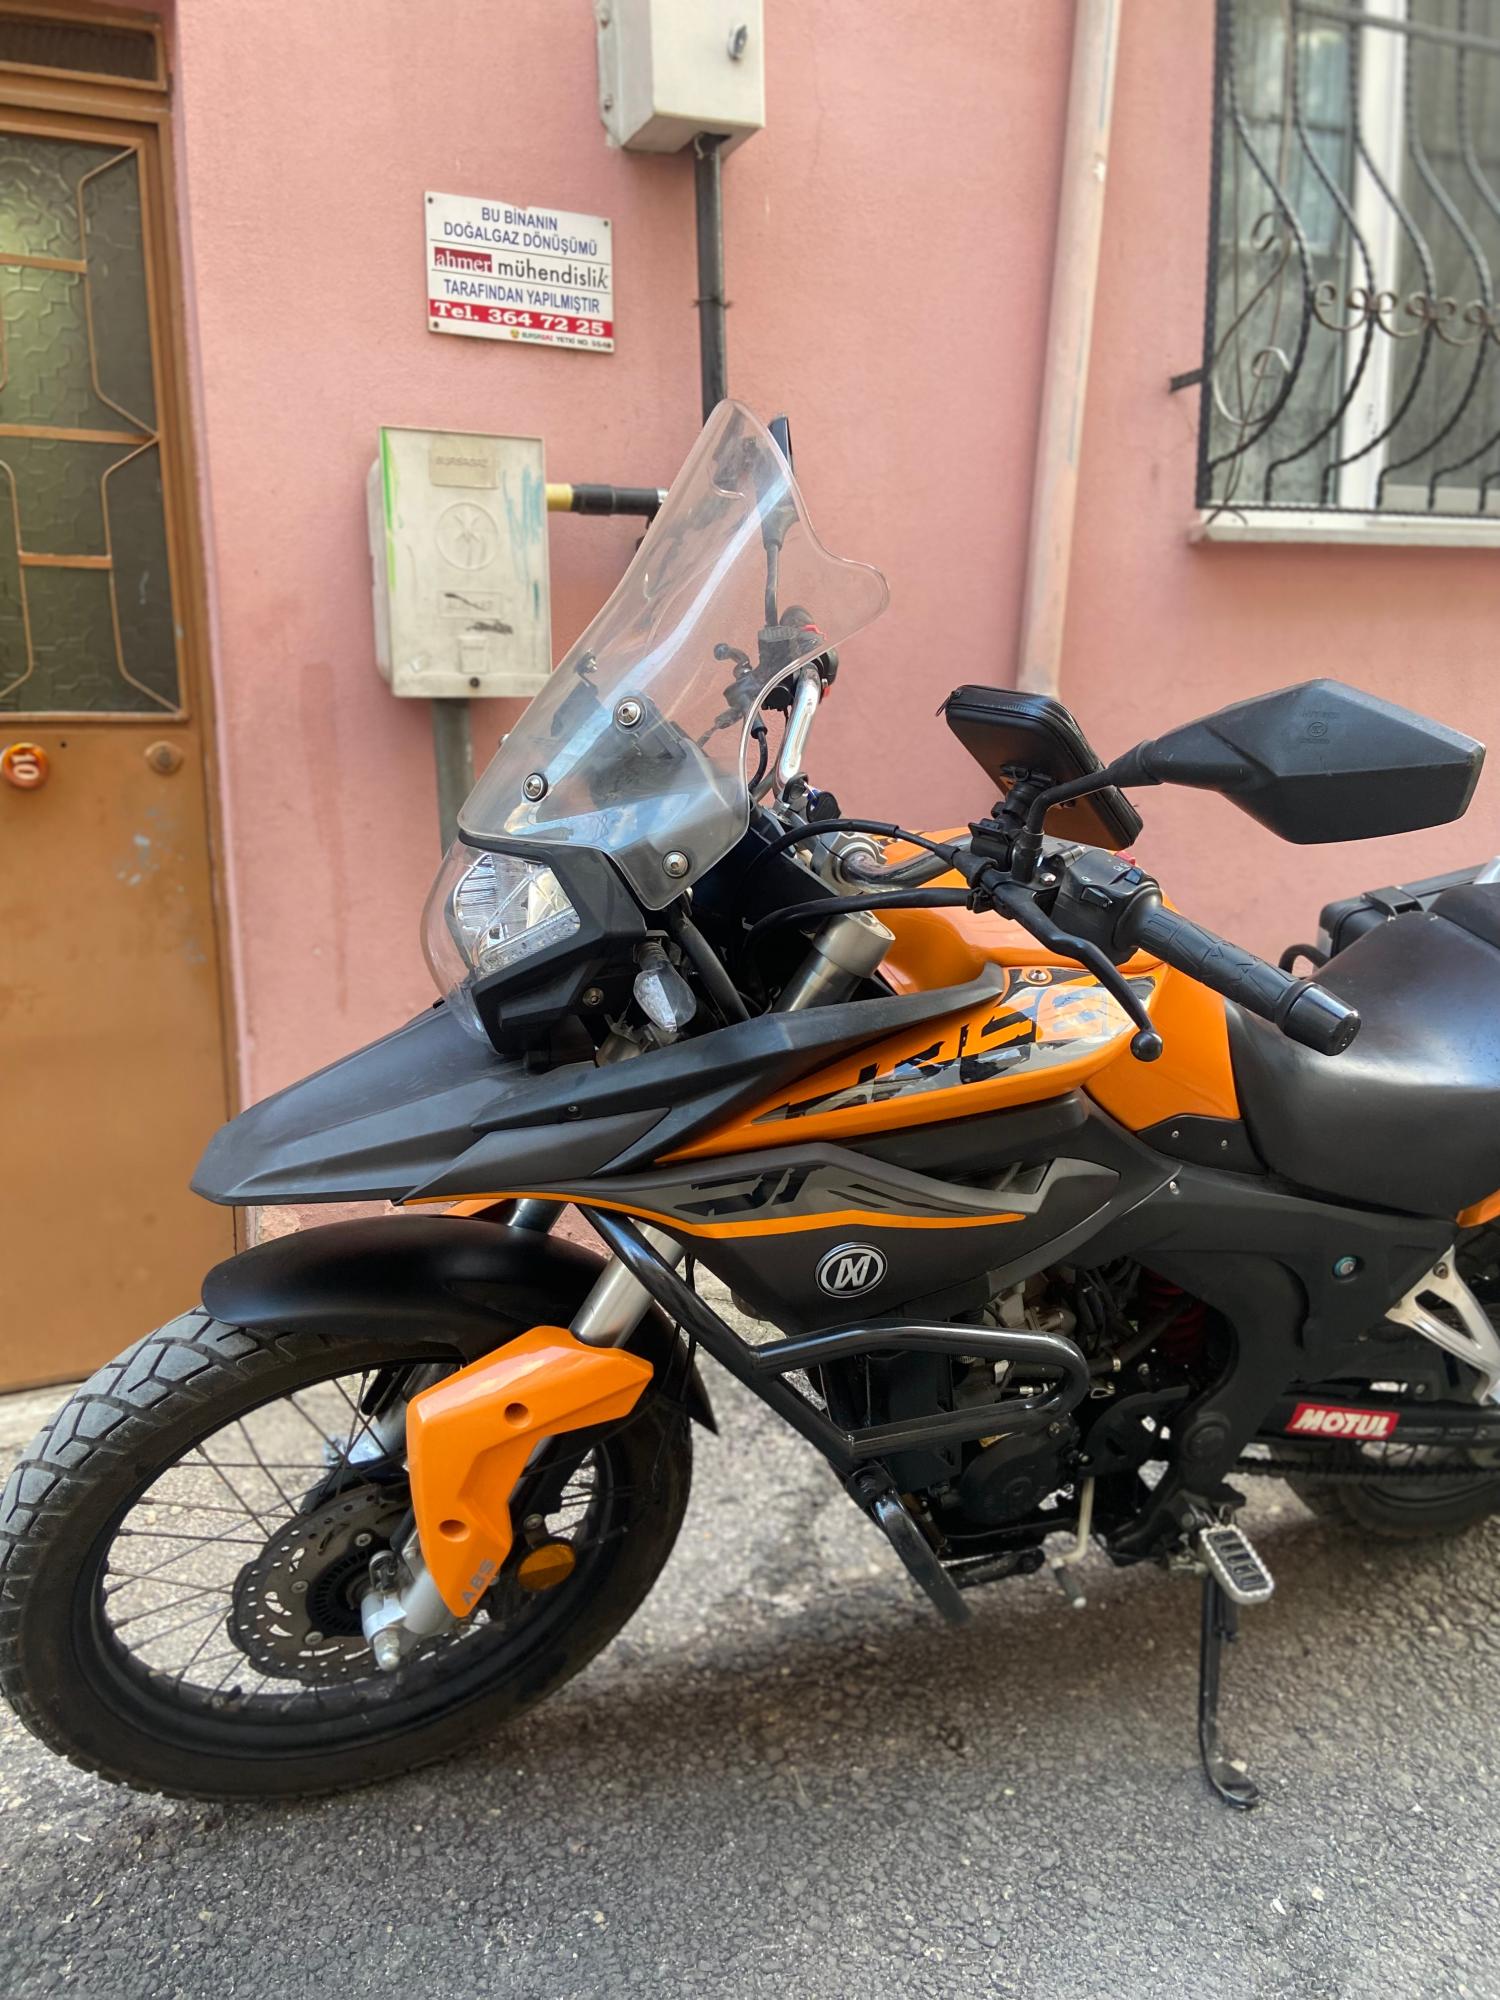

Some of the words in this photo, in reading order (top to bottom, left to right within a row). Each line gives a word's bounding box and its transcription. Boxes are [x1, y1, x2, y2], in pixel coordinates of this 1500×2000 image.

[481, 206, 500, 222] BU
[504, 208, 558, 231] BİNANIN
[444, 221, 519, 245] DOĞALGAZ
[523, 232, 597, 256] DÖNÜŞÜMÜ
[498, 258, 609, 290] mühendislik
[444, 279, 523, 304] TARAFINDAN
[526, 289, 600, 314] YAPILMIŞTIR
[434, 301, 479, 320] Tel.
[488, 308, 533, 326] 364
[540, 315, 569, 332] 72
[576, 320, 605, 336] 25
[1293, 1409, 1390, 1437] MOTUL
[462, 1558, 496, 1605] ABS
